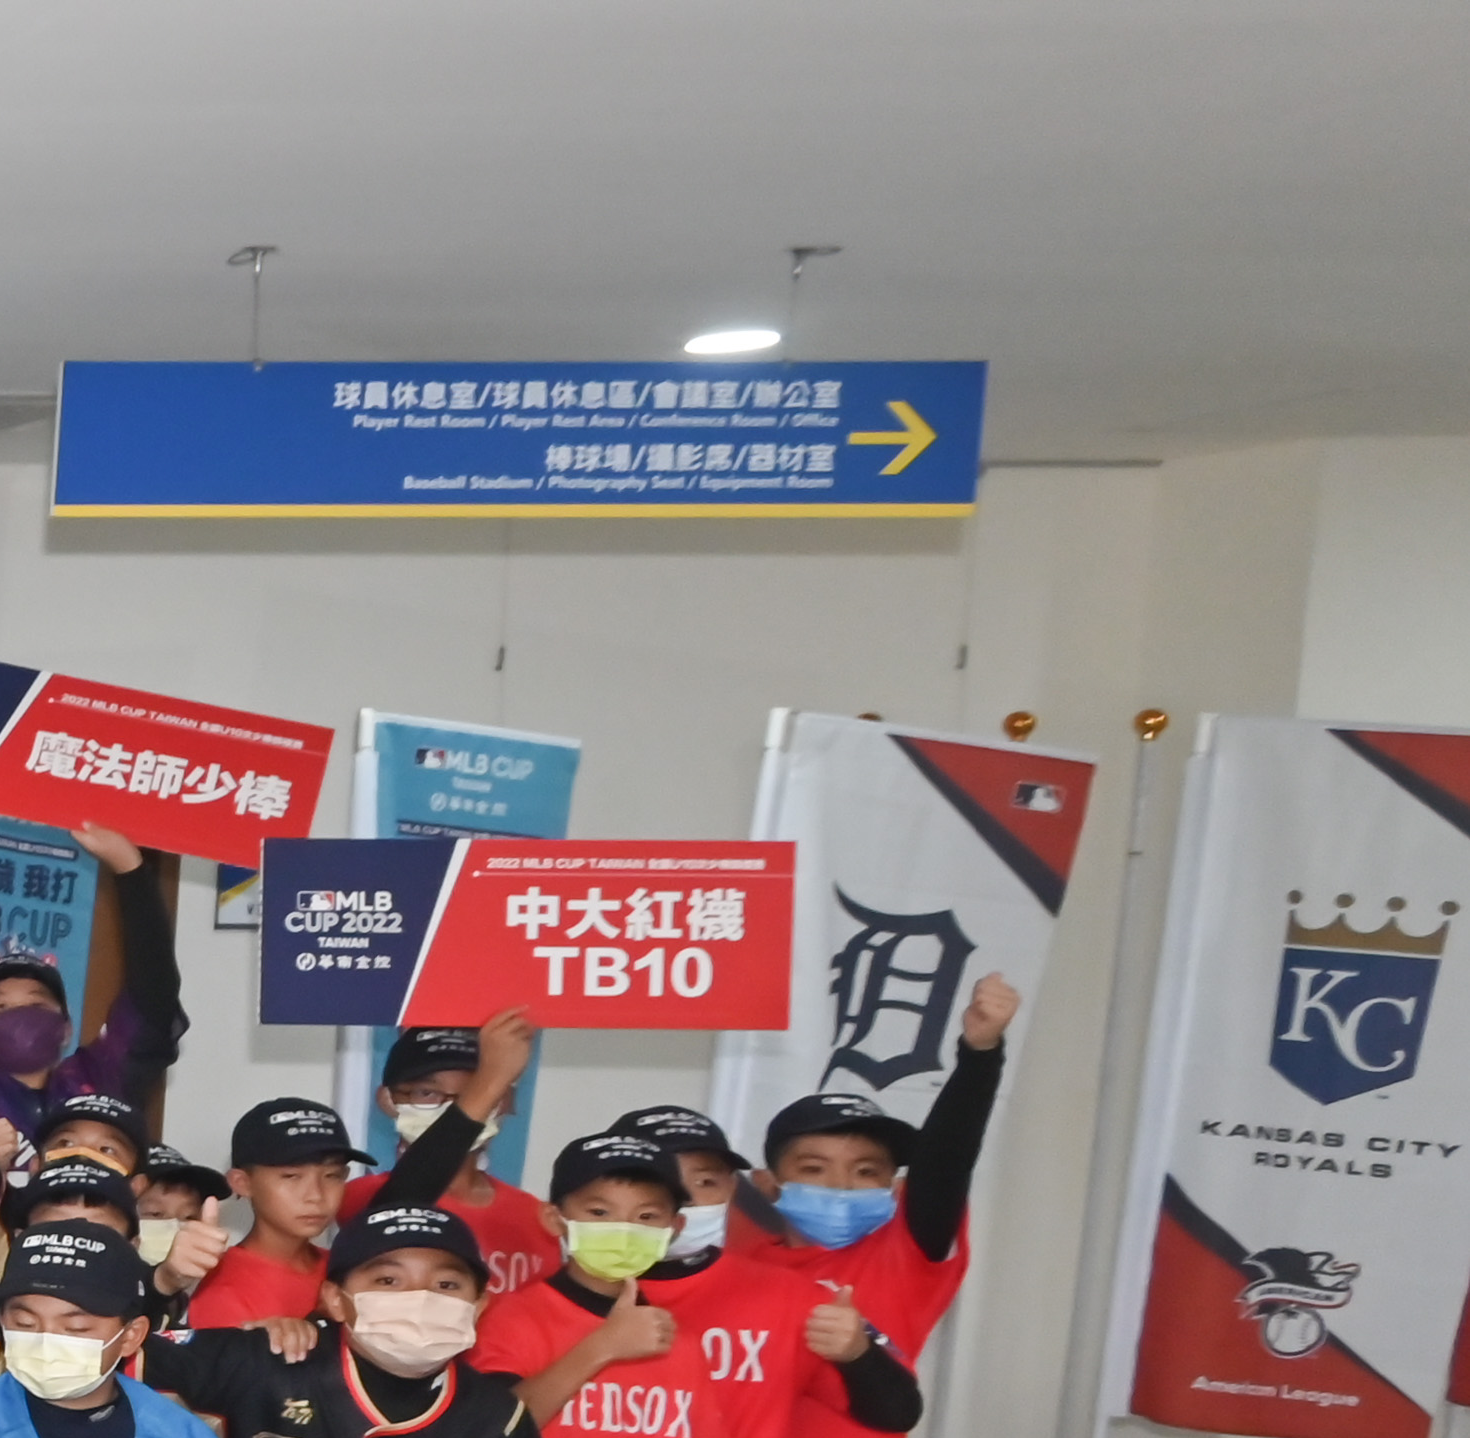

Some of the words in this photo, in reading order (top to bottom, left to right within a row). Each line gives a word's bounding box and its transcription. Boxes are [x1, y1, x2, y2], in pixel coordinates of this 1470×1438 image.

[25, 730, 292, 821] 魔法師少棒
[505, 886, 747, 942] 中大紅襪
[532, 946, 713, 998] TB10
[1199, 1119, 1346, 1150] KANSAS
[1366, 1136, 1462, 1160] CITY
[1252, 1151, 1394, 1179] ROYALS
